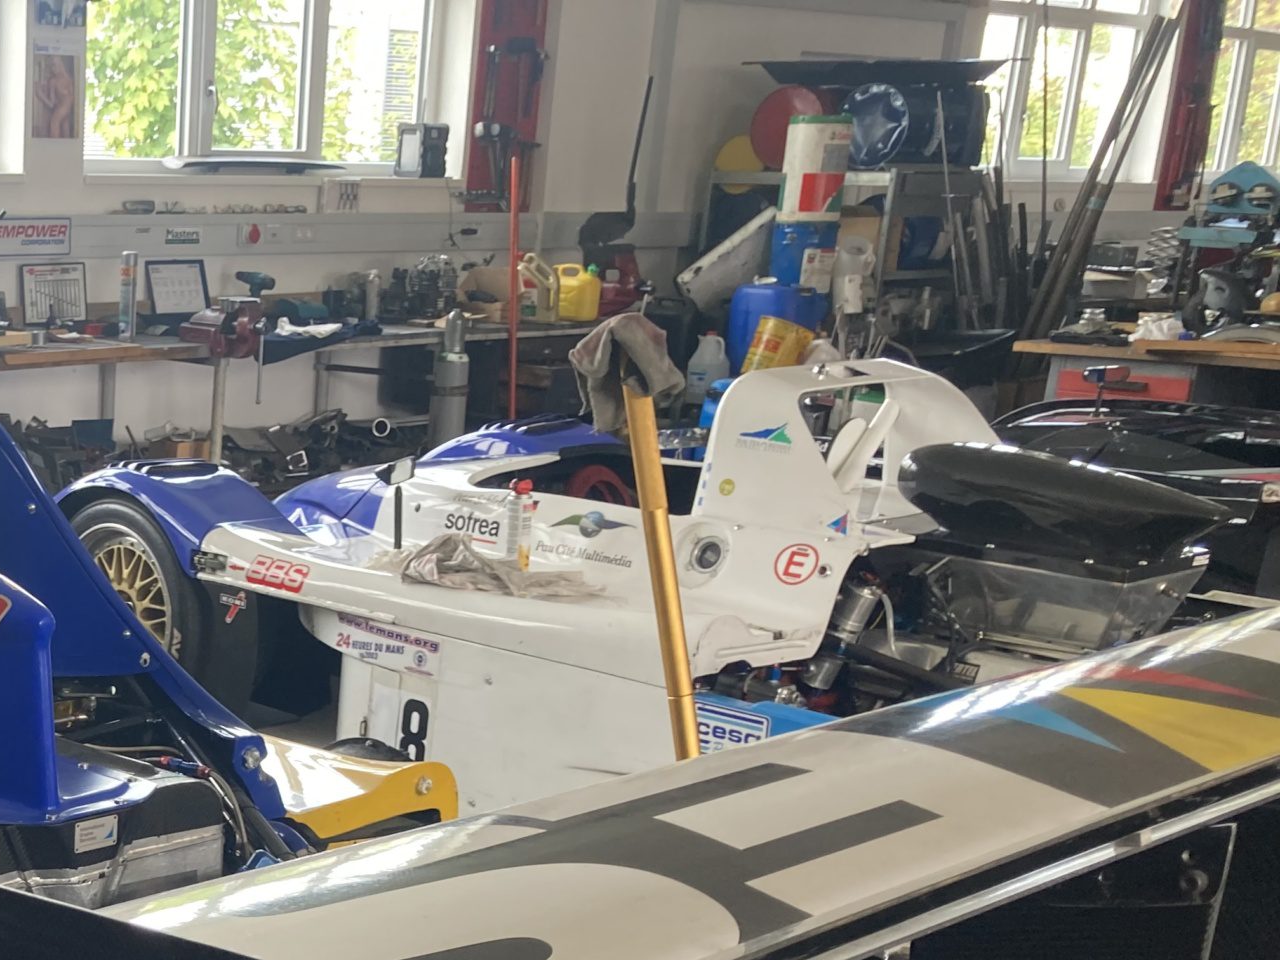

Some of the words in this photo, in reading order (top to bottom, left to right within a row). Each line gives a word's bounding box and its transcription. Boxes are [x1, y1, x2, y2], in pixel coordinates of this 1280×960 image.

[166, 228, 200, 239] Masters
[445, 511, 501, 538] sofrea
[246, 554, 311, 594] BBS
[336, 632, 352, 649] 24
[385, 643, 405, 655] MANS
